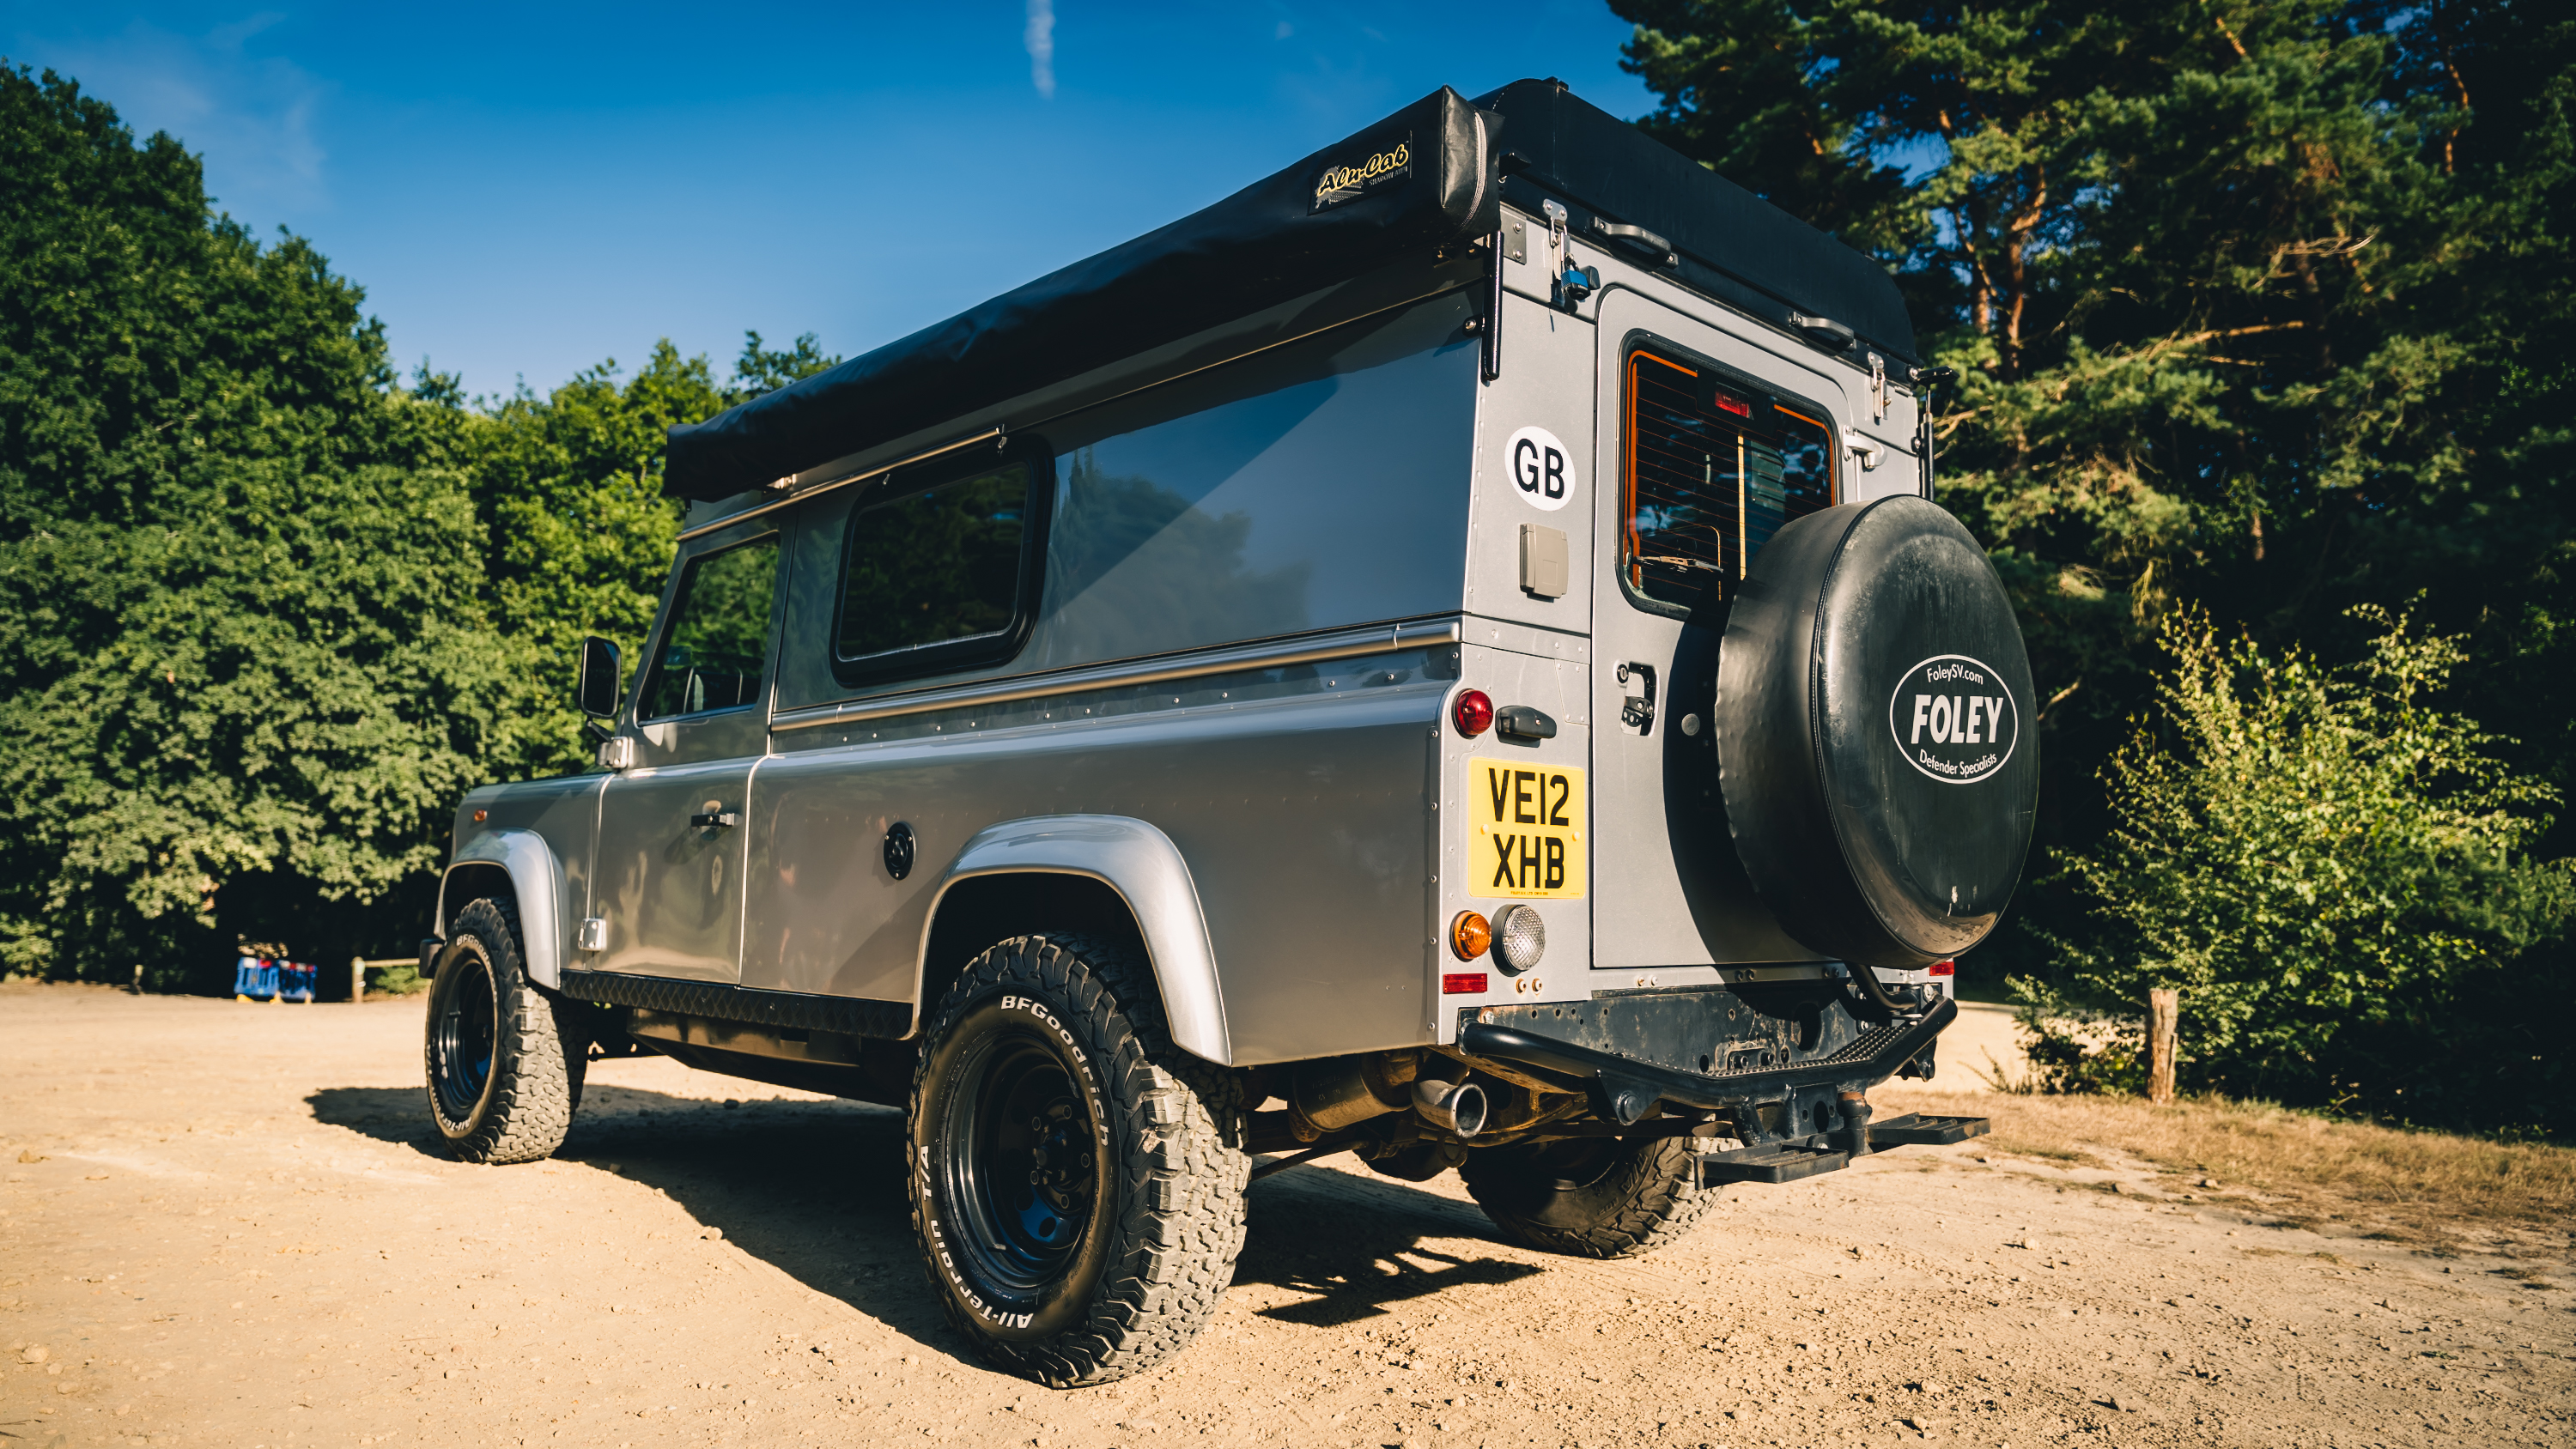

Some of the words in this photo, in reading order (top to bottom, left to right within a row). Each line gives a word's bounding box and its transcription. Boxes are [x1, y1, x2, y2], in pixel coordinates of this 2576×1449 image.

[1316, 143, 1409, 197] Alu-Cab
[1514, 438, 1564, 500] GB
[1926, 664, 1984, 685] FoleySV.com
[1911, 694, 2004, 744] FOLEY
[1919, 749, 1959, 775] Defender
[1959, 753, 1997, 779] Specialists
[1488, 767, 1570, 827] VE12
[1492, 833, 1565, 889] XHB
[1000, 995, 1109, 1147] BFGoodrich
[920, 1145, 933, 1201] T/A
[929, 1219, 1034, 1329] All-Terrain
